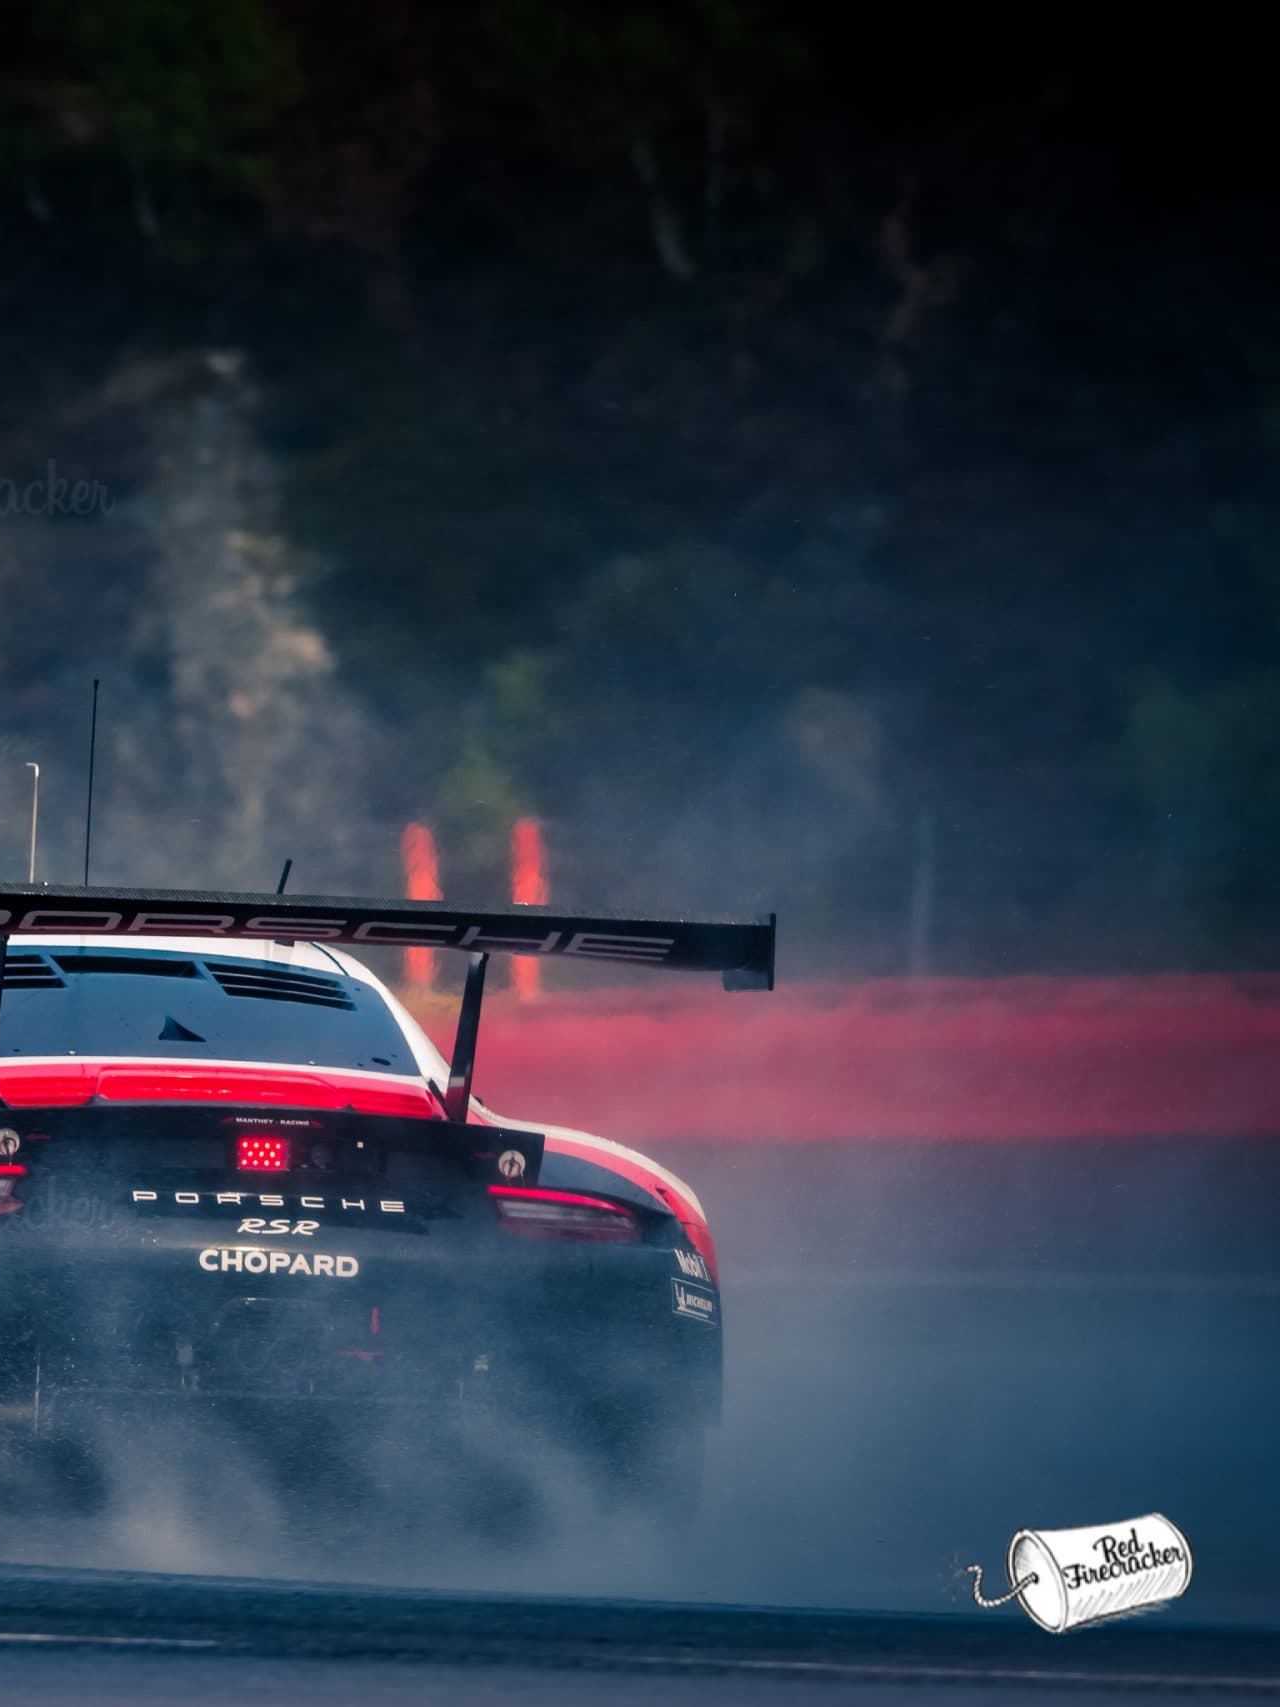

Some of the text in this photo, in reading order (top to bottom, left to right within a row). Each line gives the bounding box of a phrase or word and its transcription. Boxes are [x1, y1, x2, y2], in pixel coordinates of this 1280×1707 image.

[132, 1190, 405, 1213] PORSCHE
[237, 1218, 320, 1236] RSR
[198, 1249, 359, 1278] CHOPARD
